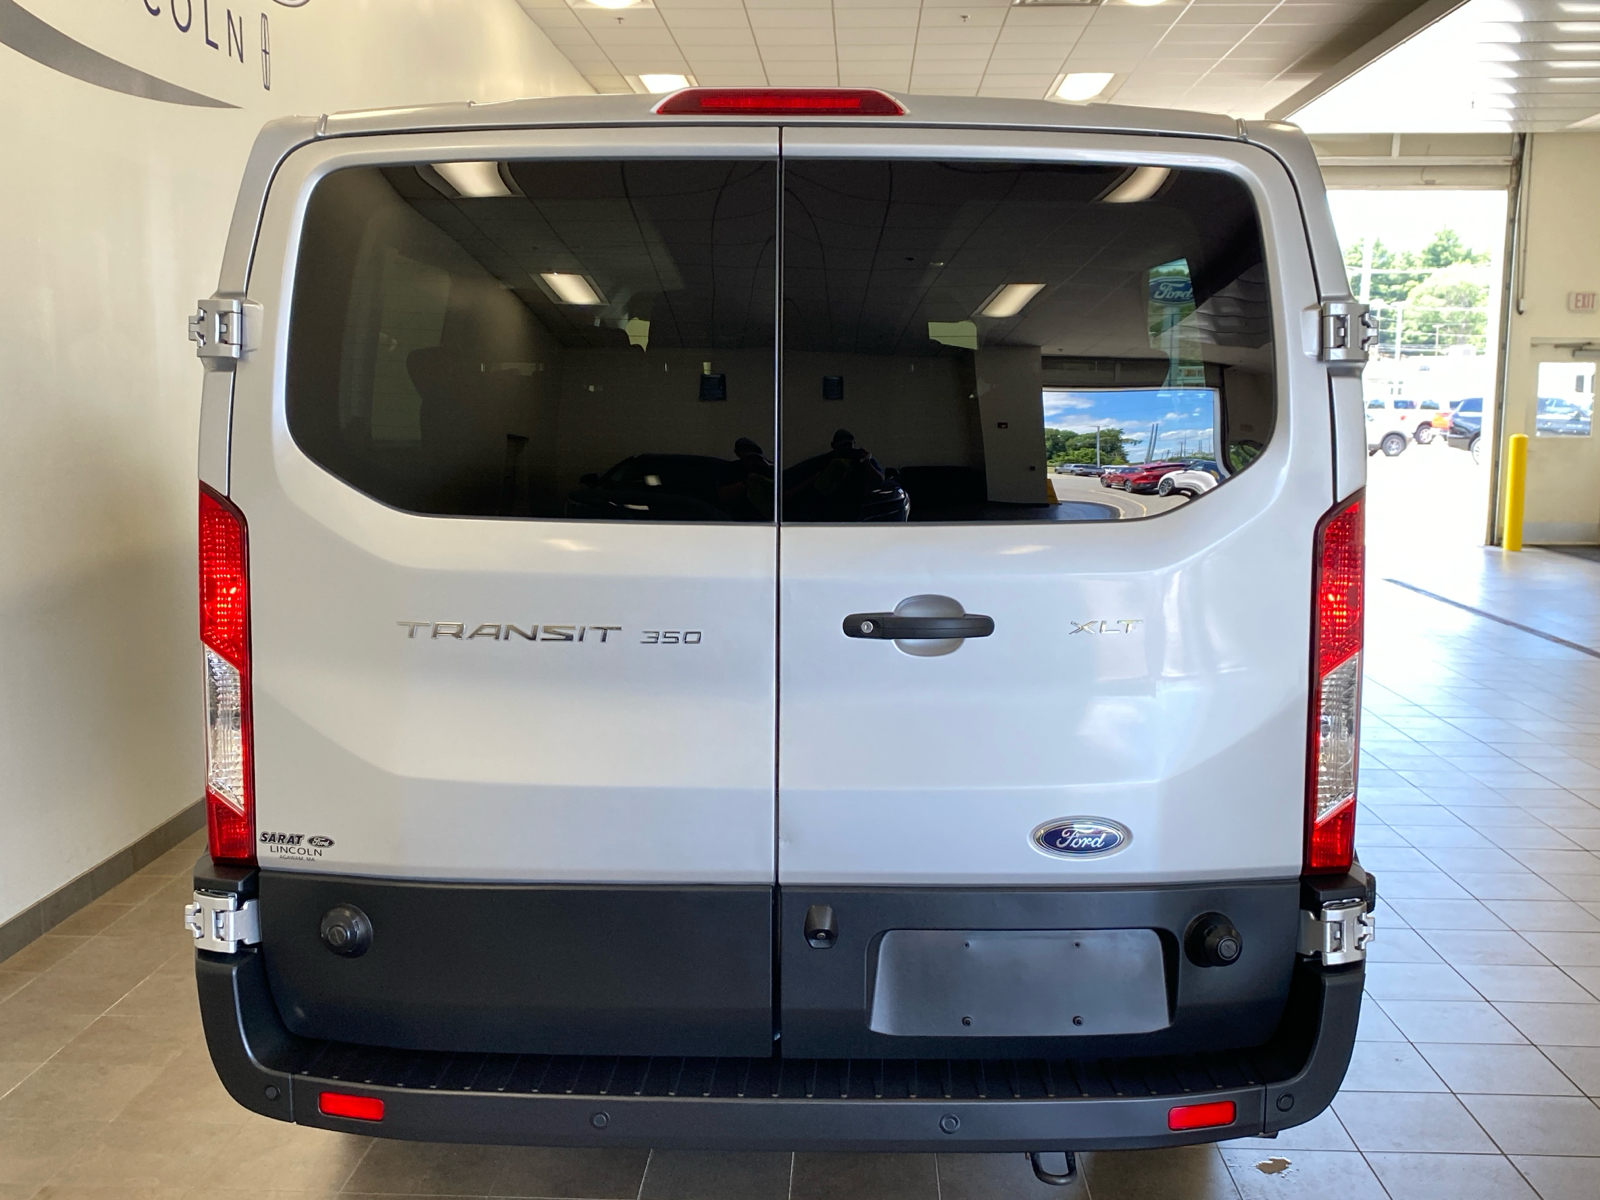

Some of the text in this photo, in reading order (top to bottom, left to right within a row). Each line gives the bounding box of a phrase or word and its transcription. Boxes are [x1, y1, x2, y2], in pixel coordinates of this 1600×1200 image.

[143, 0, 244, 63] OLN
[1153, 282, 1193, 300] Ford
[1574, 292, 1596, 309] EXIT
[397, 621, 702, 644] TRANSIT 350
[1069, 619, 1144, 635] XLT
[260, 832, 305, 846] SARAT
[1056, 826, 1107, 849] Ford
[270, 845, 323, 857] LINCOLN
